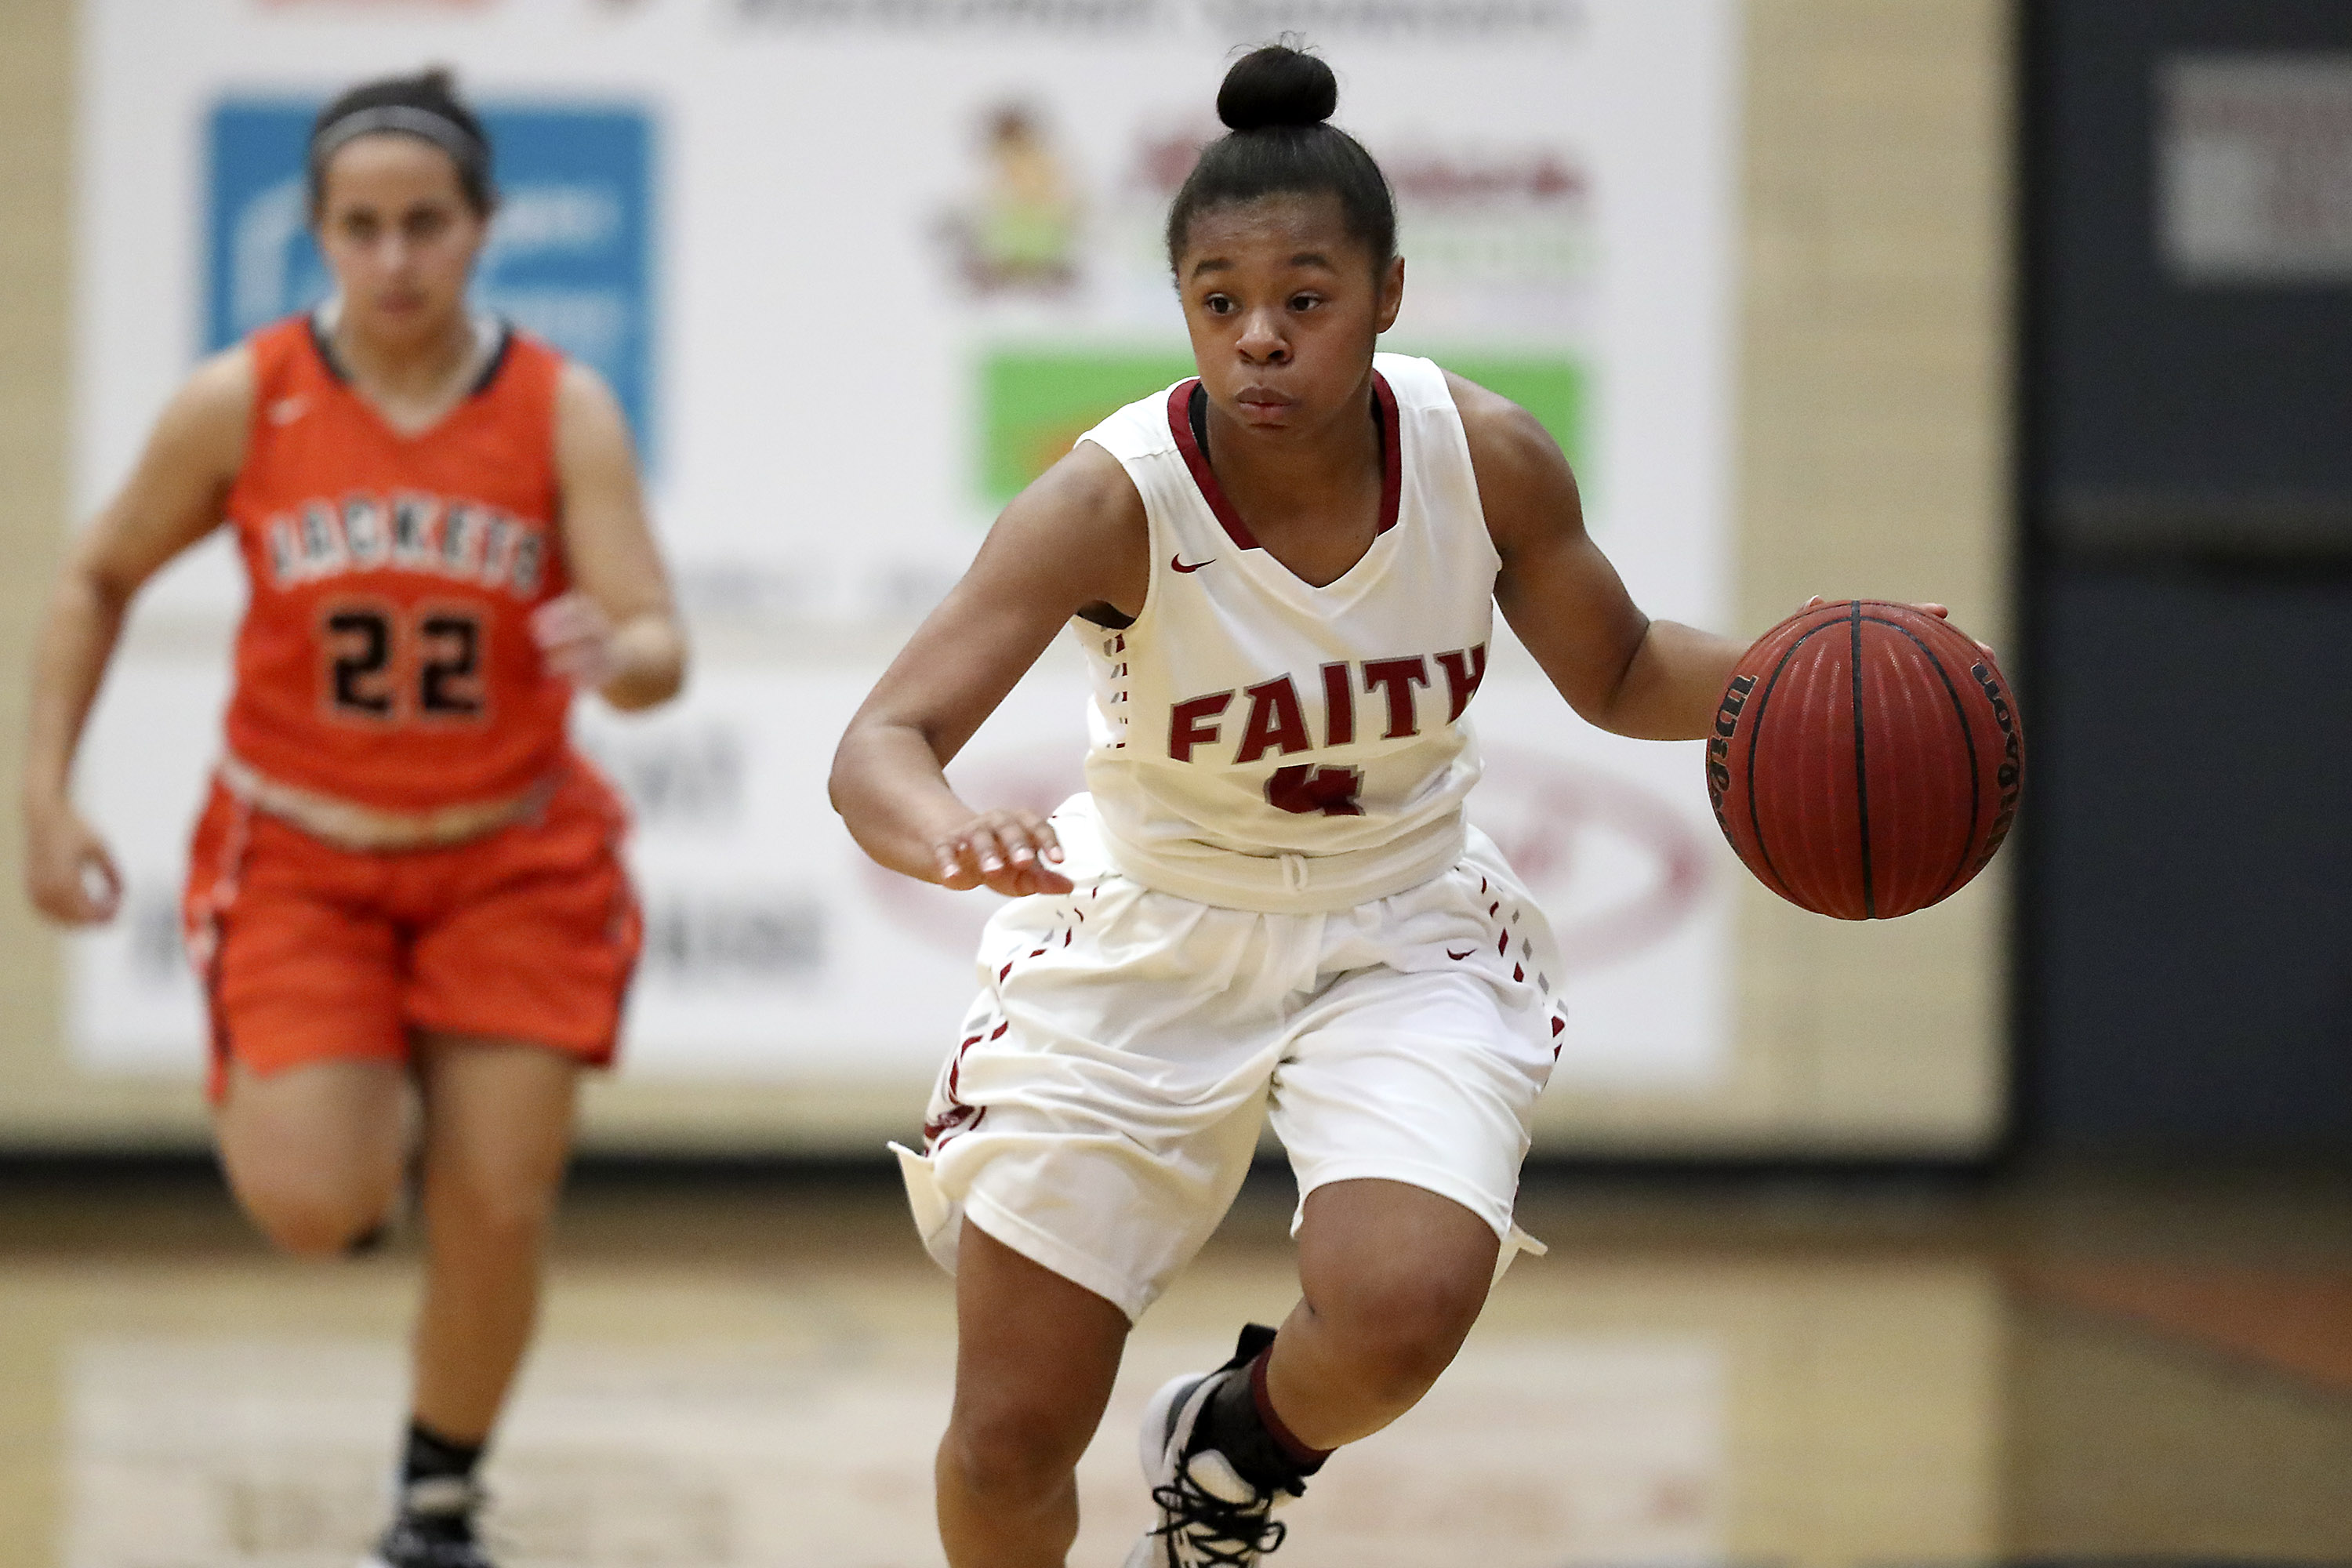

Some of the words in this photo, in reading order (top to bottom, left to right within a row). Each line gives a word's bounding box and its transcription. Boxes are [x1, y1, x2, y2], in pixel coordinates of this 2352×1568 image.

[265, 489, 546, 597] JACKETS
[323, 605, 488, 718] 22
[1167, 641, 1487, 765] FAITH
